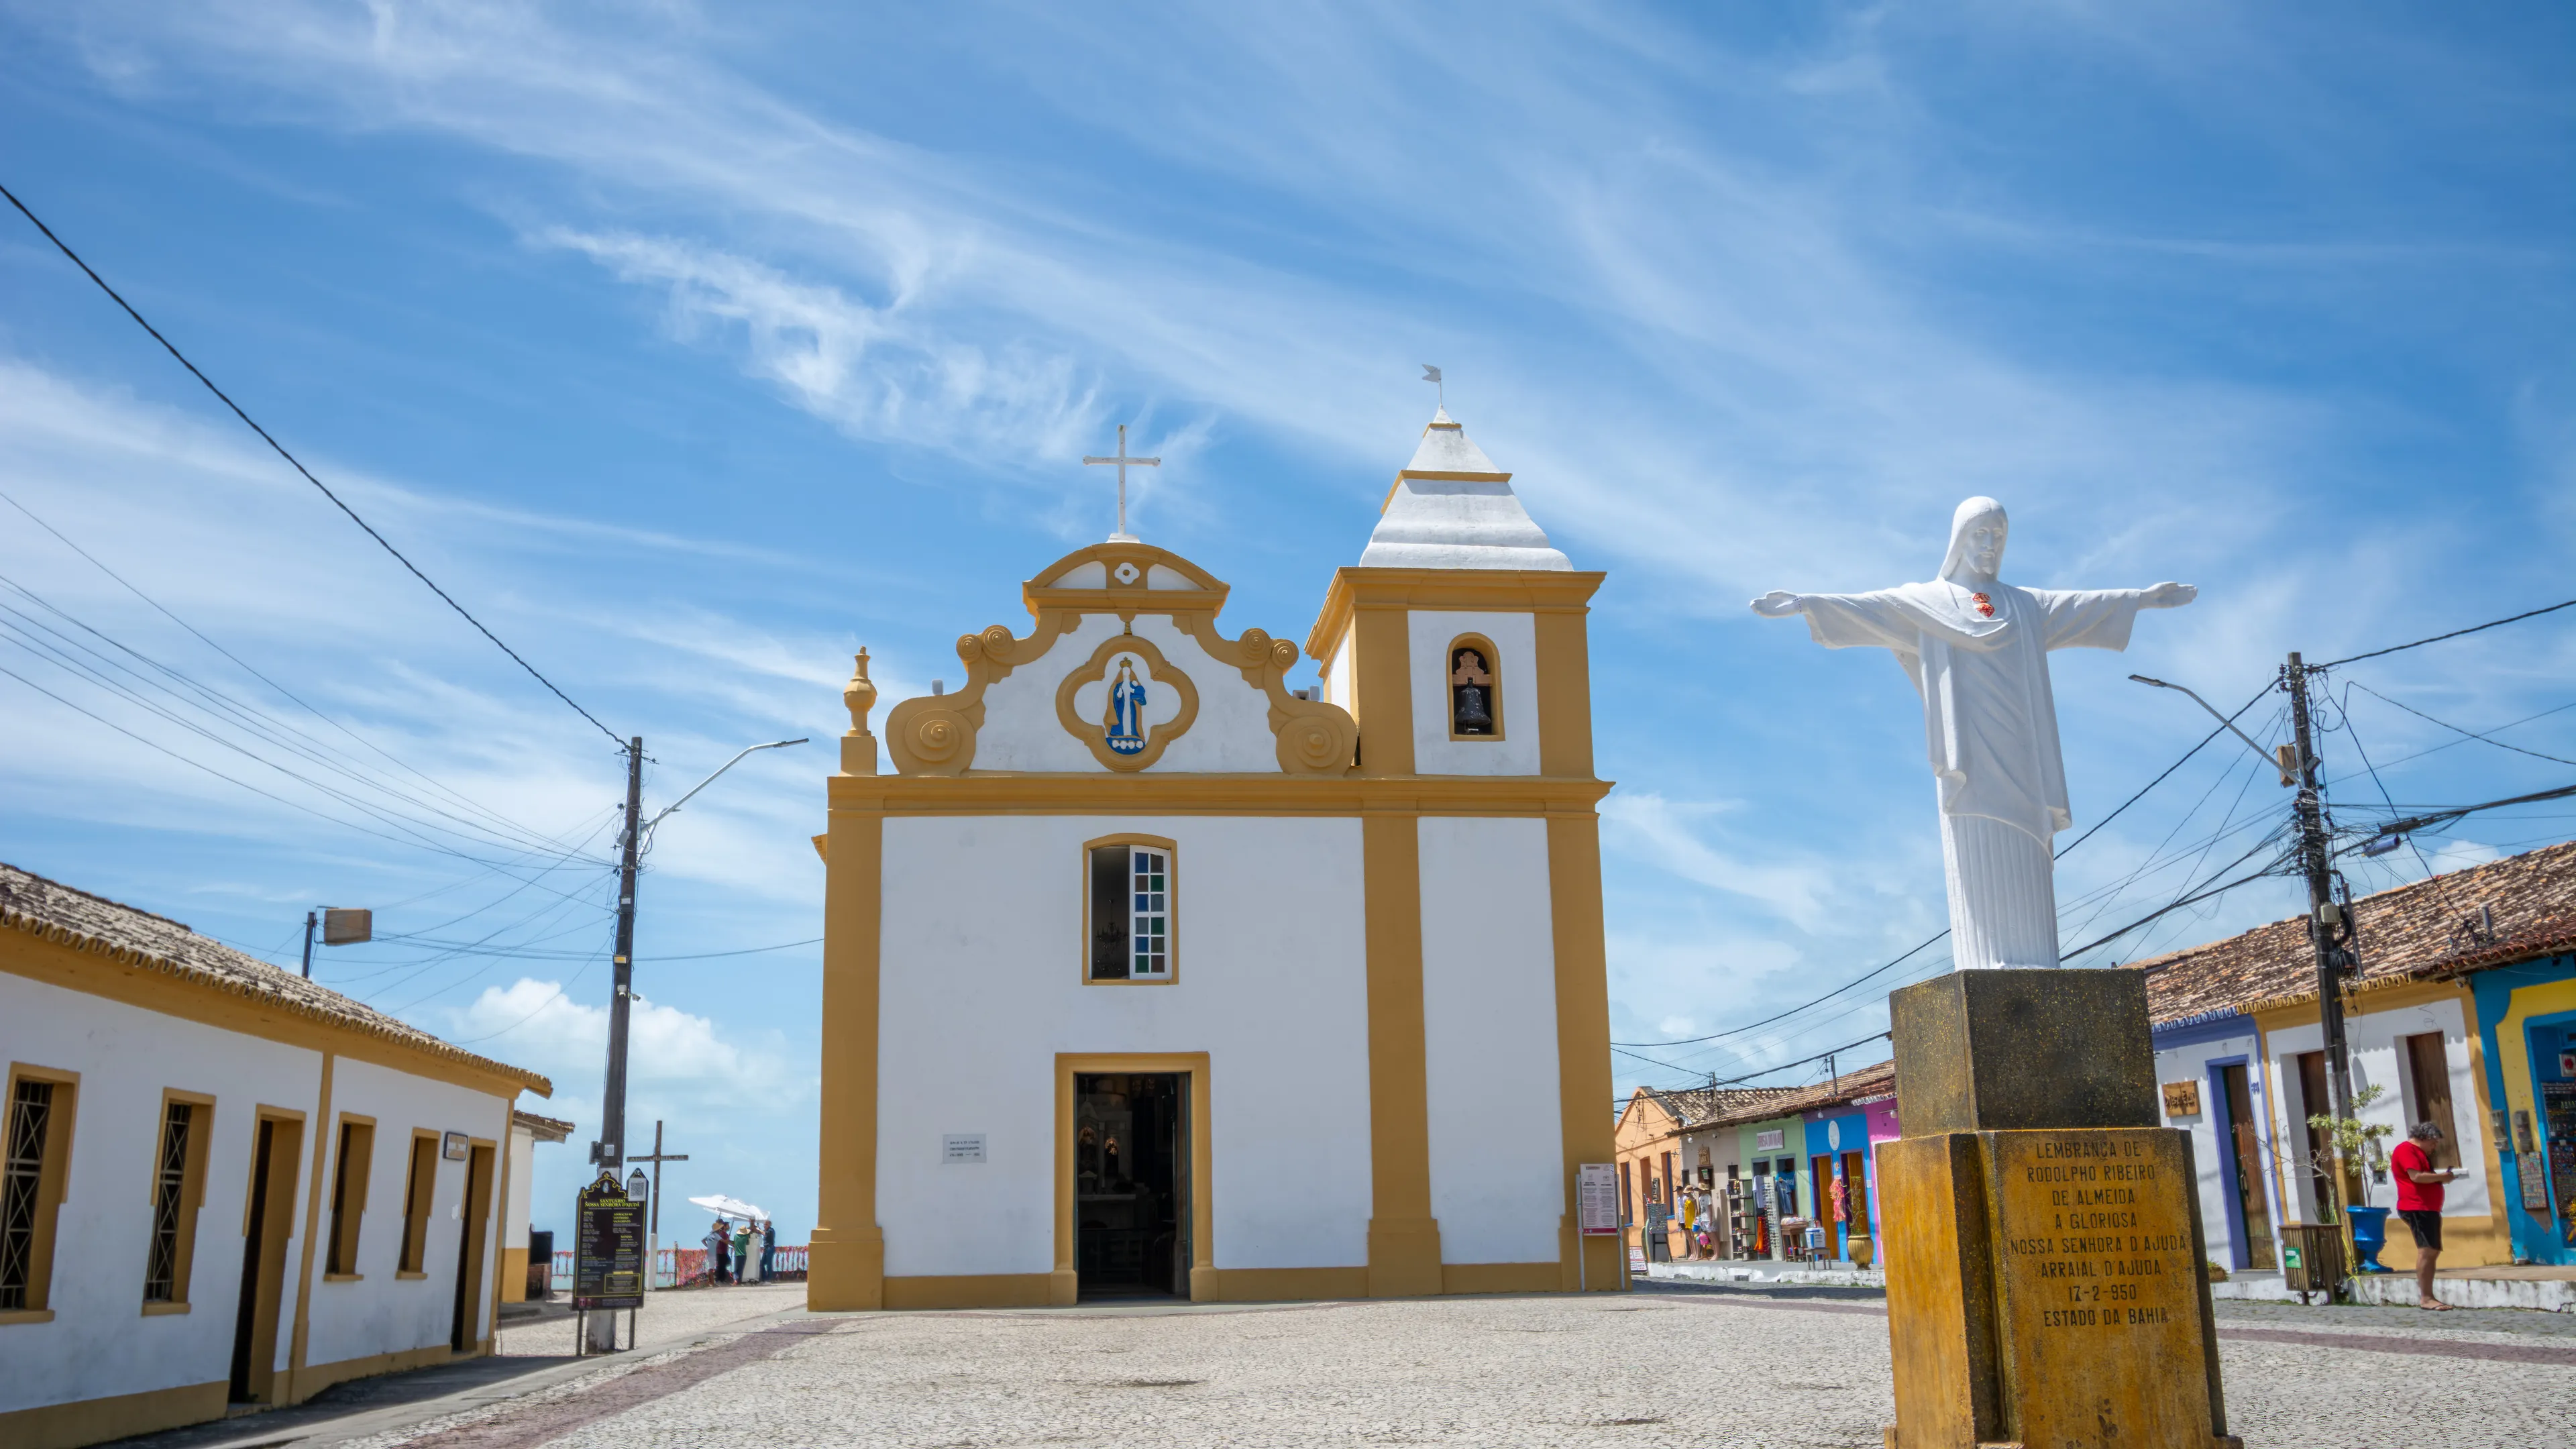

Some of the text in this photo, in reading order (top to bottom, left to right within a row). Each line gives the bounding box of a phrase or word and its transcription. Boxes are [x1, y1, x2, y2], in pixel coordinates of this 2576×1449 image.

[2125, 1141, 2141, 1157] DE
[2027, 1165, 2155, 1183] RODOLPHO RIBEIRO
[2053, 1189, 2135, 1206] DE ALMEIDA
[2055, 1213, 2137, 1230] A GLORIOSA
[2010, 1238, 2054, 1254] NOSSA
[2063, 1237, 2122, 1253] SENHORA
[2041, 1260, 2161, 1278] ARRAIAL D'AJUDA
[2043, 1307, 2169, 1327] ESTADO DA BAHIA
